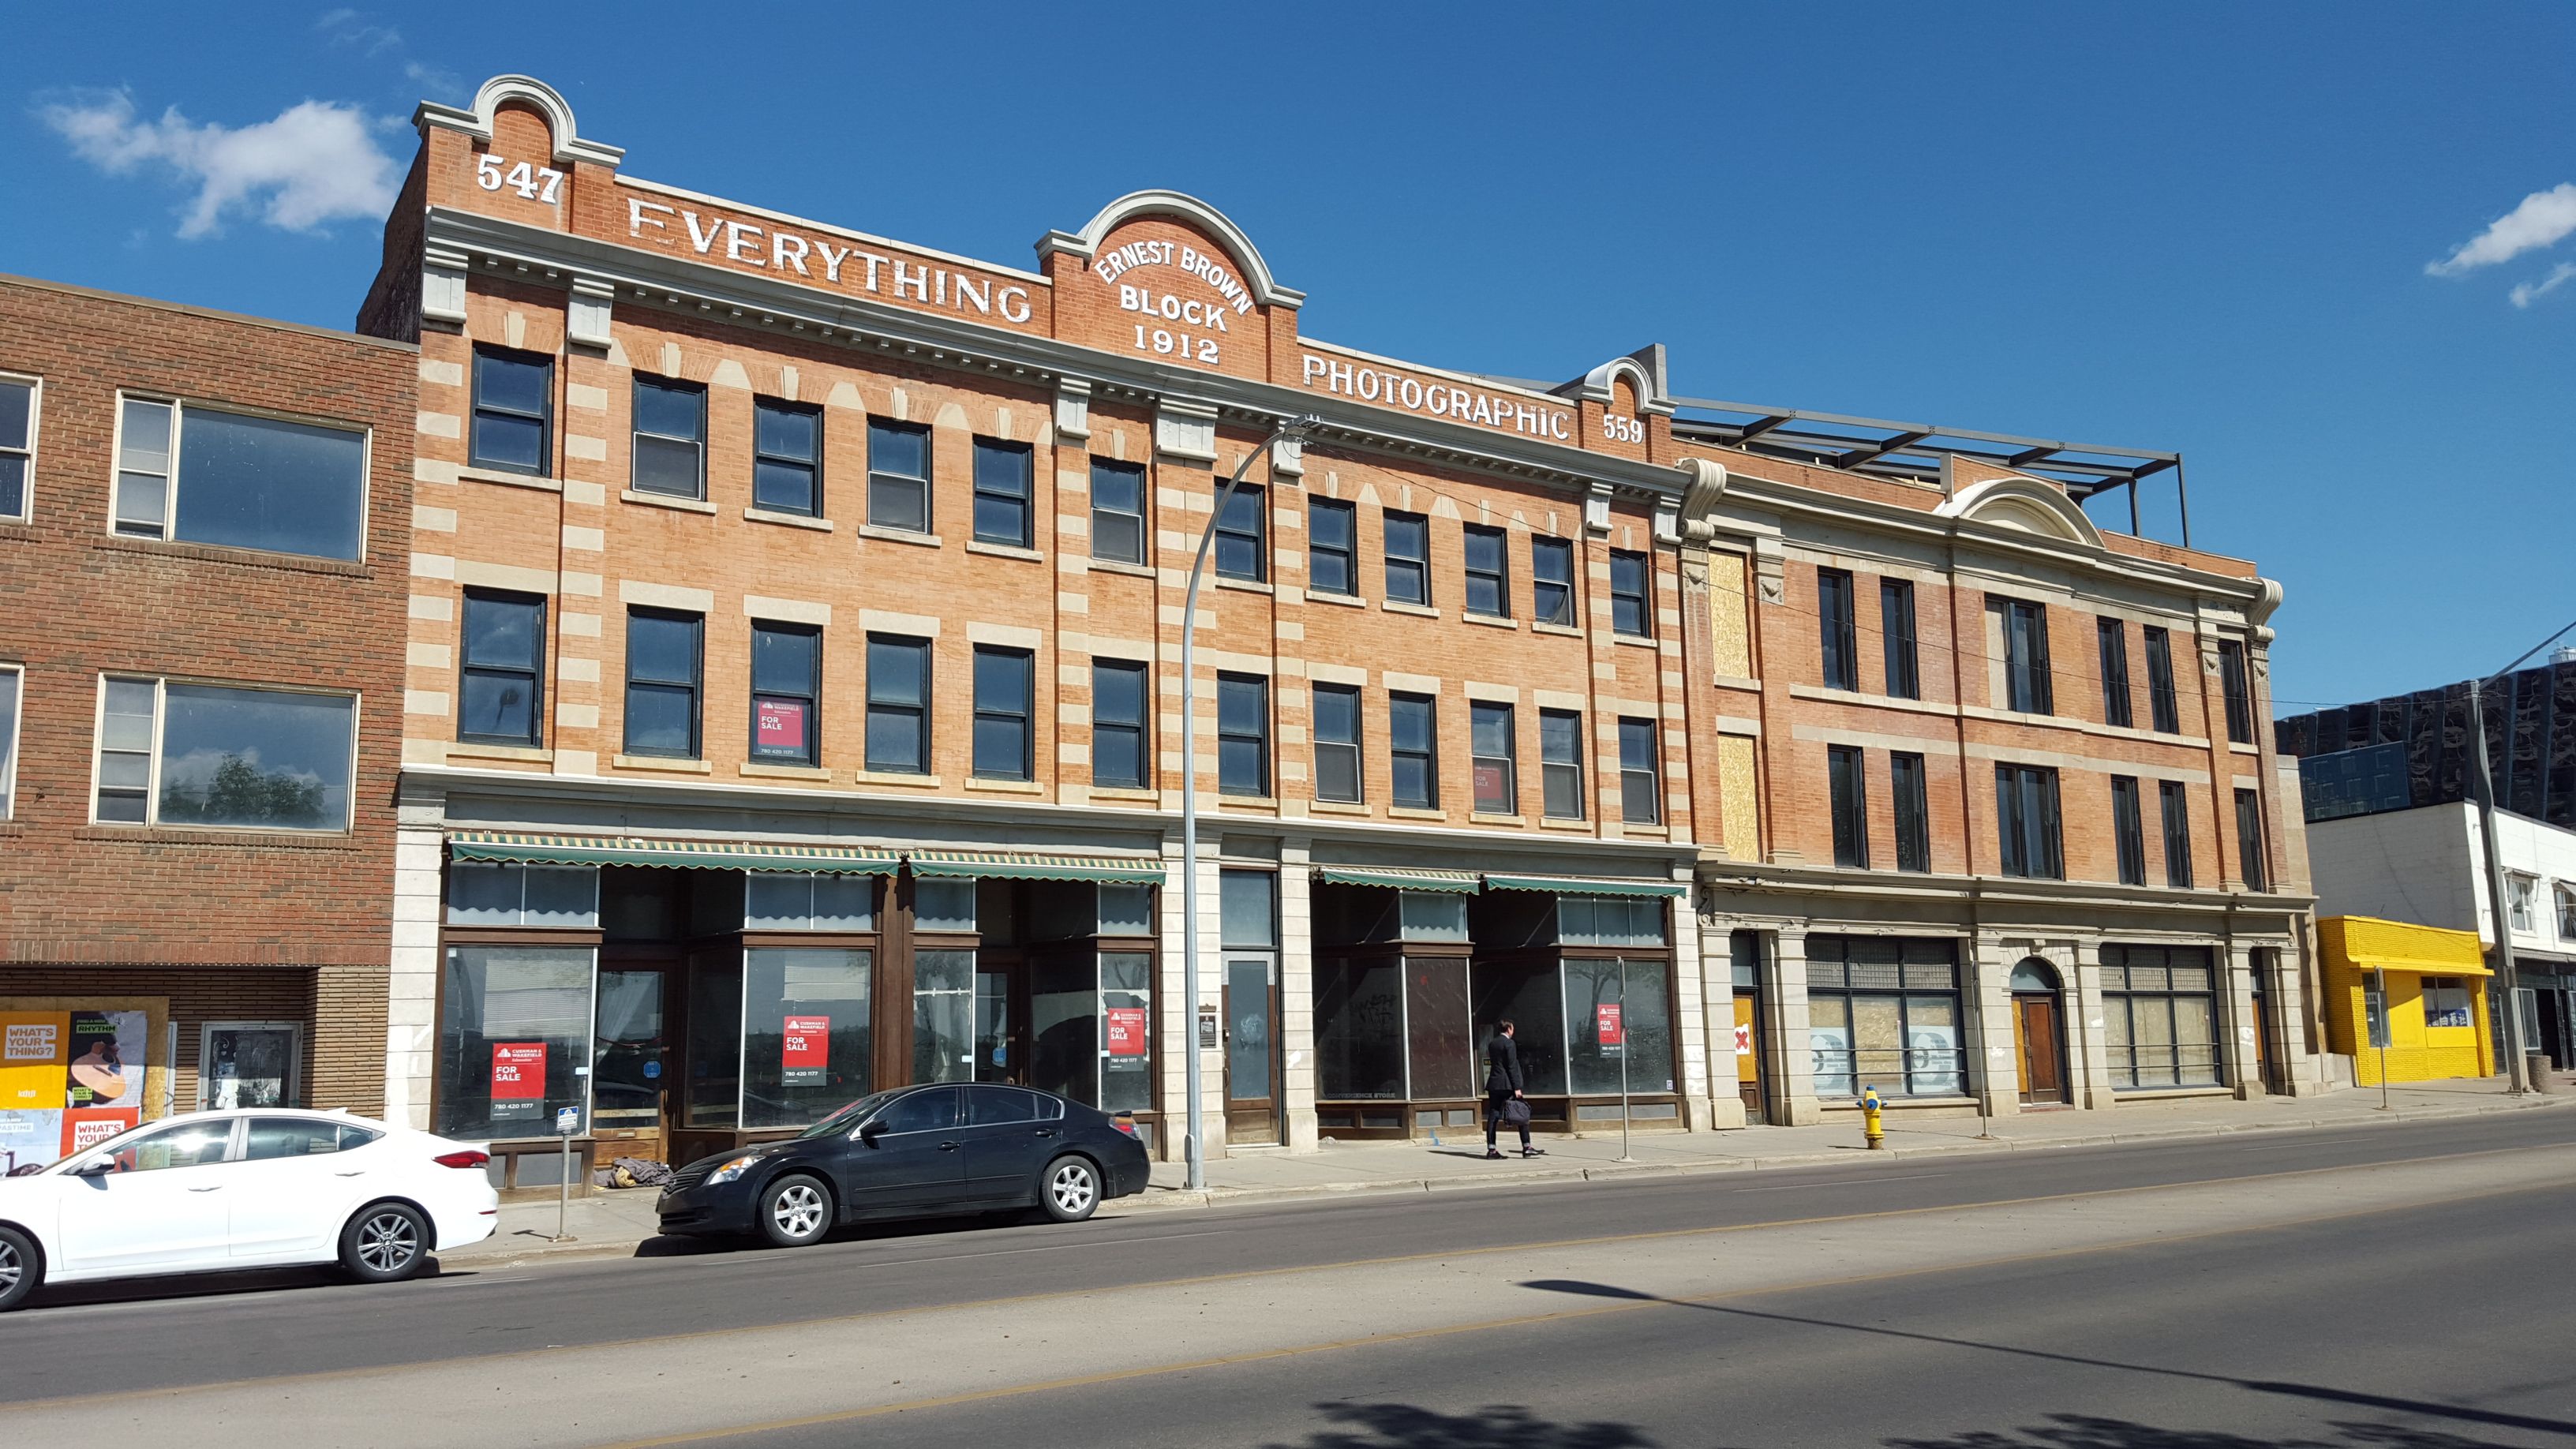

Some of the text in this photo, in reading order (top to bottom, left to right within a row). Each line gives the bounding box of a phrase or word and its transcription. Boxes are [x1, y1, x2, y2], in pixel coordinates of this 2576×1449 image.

[477, 153, 564, 204] 547
[627, 197, 1031, 323] EVERYTHING
[1094, 241, 1253, 316] ERNEST BROWN
[1119, 284, 1227, 332] BLOCK
[1134, 324, 1219, 365] 1912
[1302, 354, 1569, 440] PHOTOGRAPHIC
[1603, 414, 1643, 444] 559
[8, 1046, 53, 1056] THING?
[9, 1028, 54, 1037] WHAT'S
[9, 1037, 43, 1046] YOUR
[78, 1124, 122, 1133] WHAT'S
